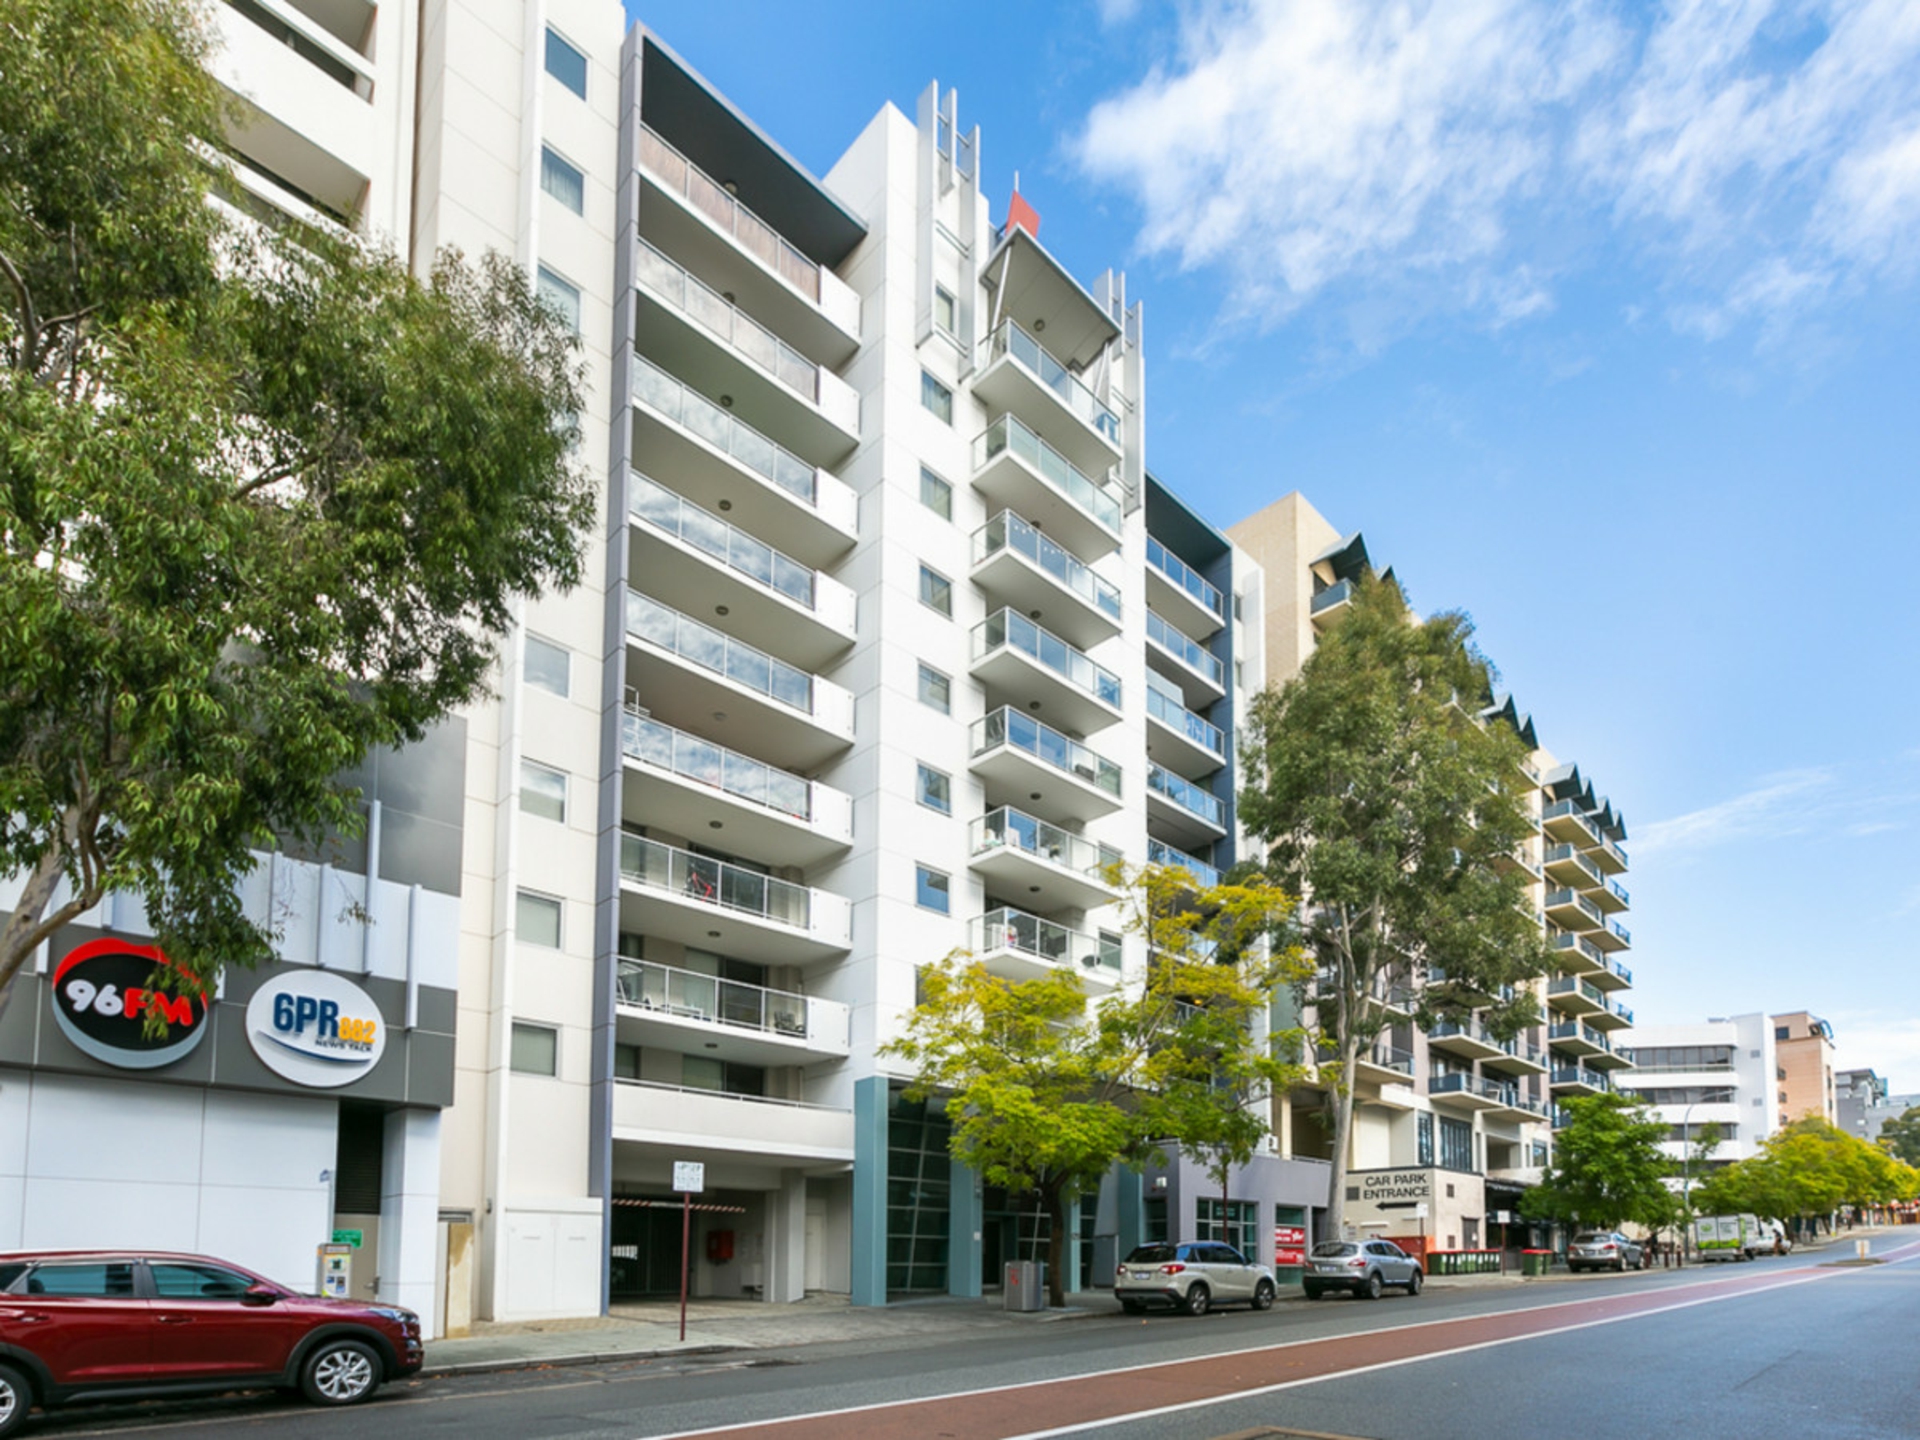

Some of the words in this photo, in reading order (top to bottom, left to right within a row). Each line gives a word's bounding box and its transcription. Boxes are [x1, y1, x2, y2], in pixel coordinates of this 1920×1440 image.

[66, 979, 193, 1026] 96FM
[315, 1039, 345, 1050] NEWS
[1365, 1175, 1391, 1187] CAR
[1394, 1173, 1427, 1185] PARK
[1363, 1186, 1430, 1200] ENTRANCE
